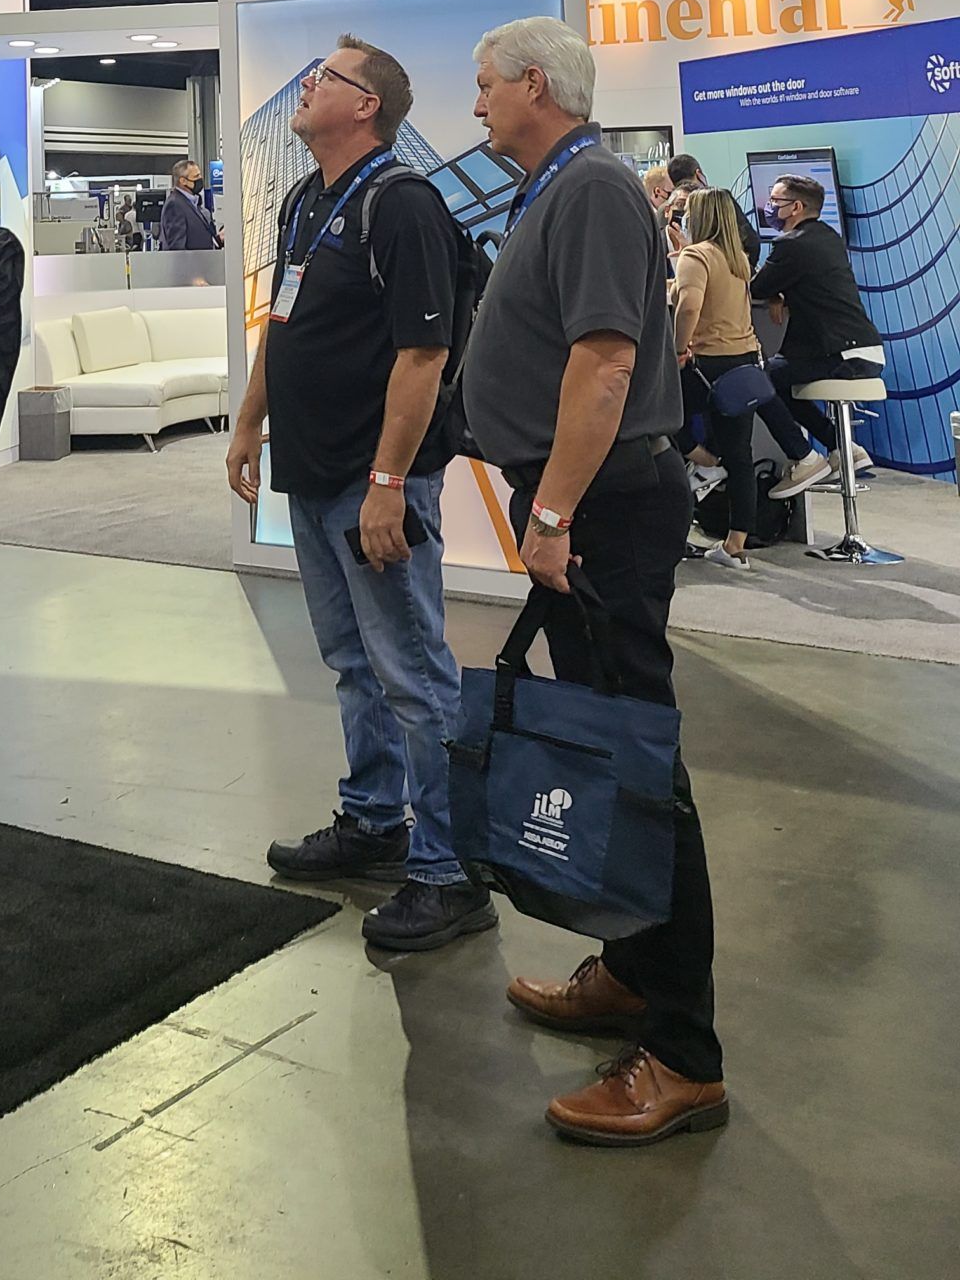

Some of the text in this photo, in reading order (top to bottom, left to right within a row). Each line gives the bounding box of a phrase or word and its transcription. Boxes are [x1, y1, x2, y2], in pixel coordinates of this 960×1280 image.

[693, 78, 806, 101] Get more windows out the door
[785, 92, 807, 101] window
[807, 90, 819, 99] and
[819, 89, 833, 98] door
[833, 86, 860, 97] software
